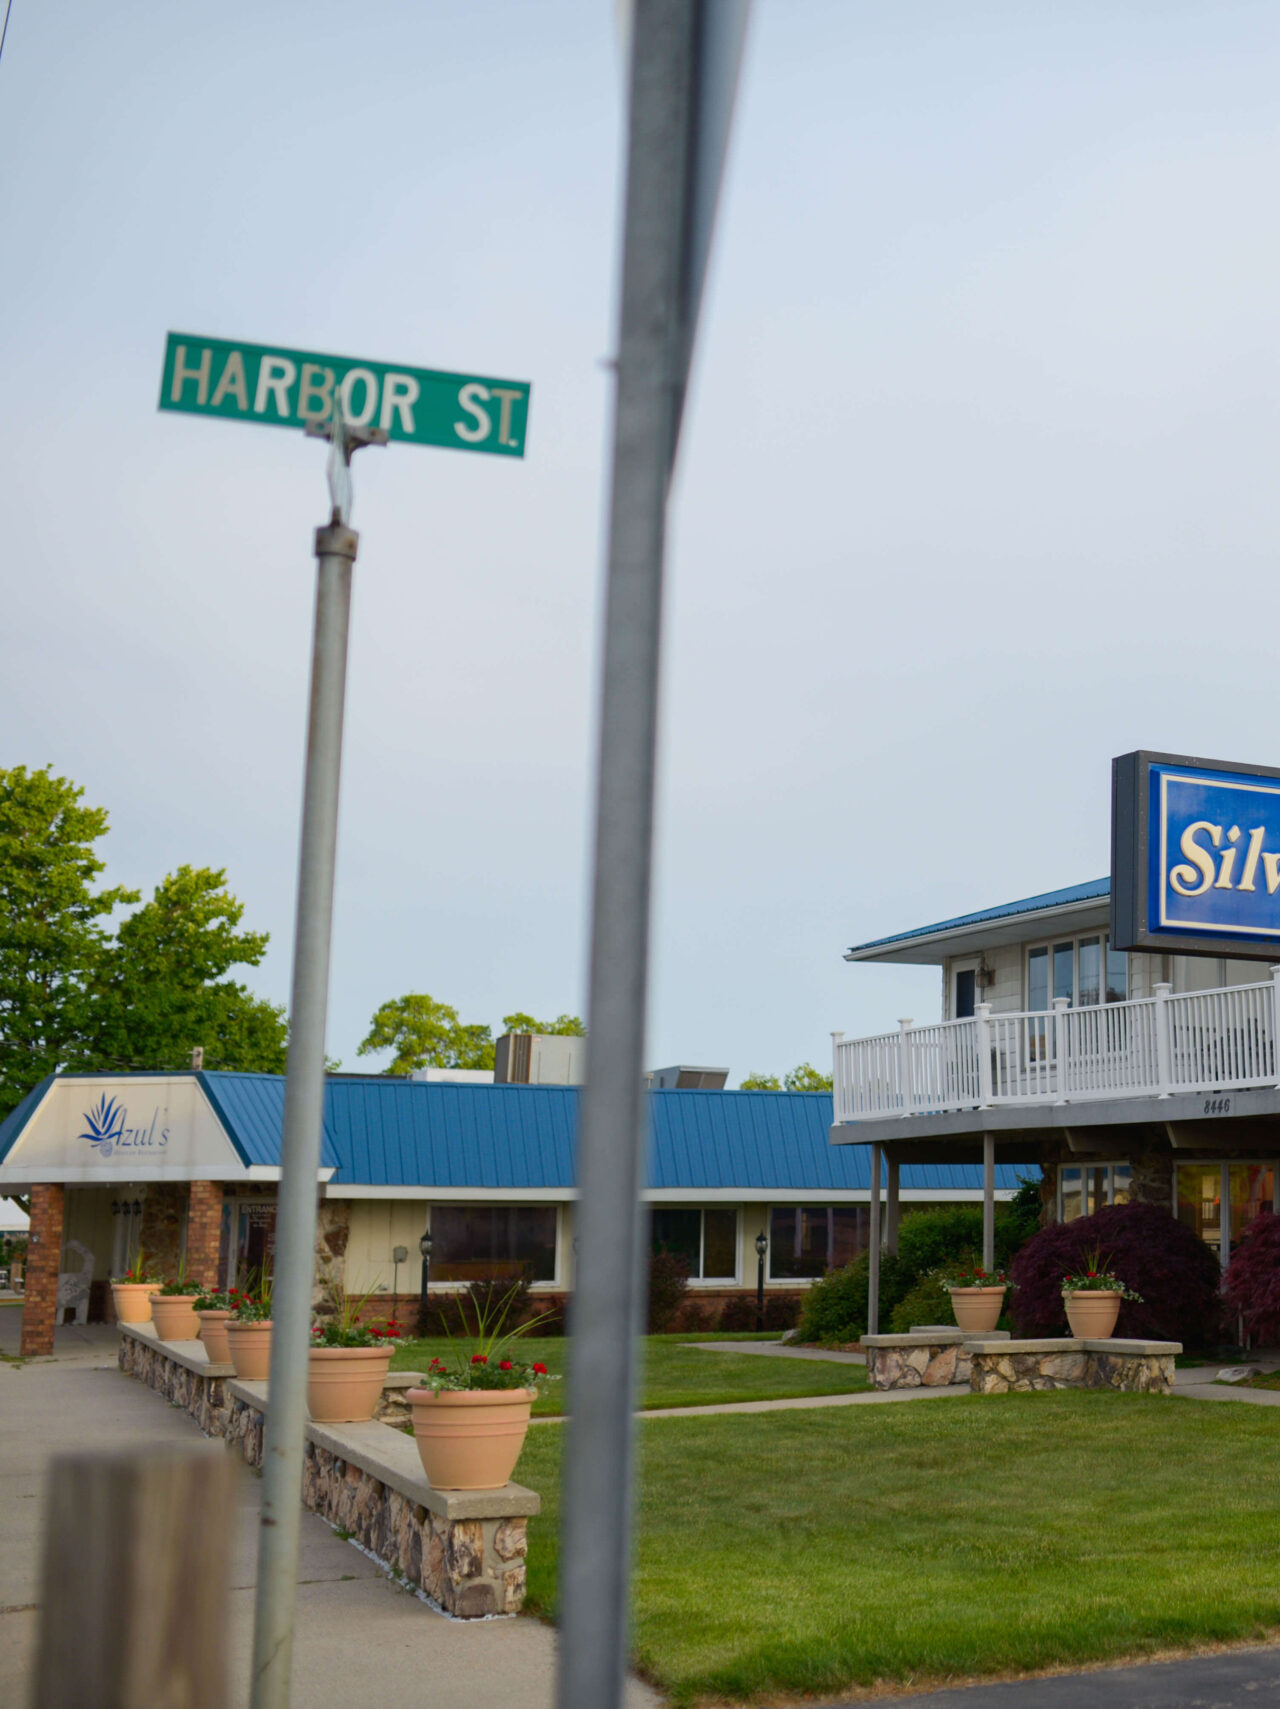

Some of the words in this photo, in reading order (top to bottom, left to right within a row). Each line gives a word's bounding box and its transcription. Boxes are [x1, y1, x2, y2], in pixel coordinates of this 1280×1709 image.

[170, 345, 420, 434] HARBOR
[454, 382, 524, 448] ST.
[110, 1105, 170, 1147] Azul's
[1204, 1098, 1231, 1115] 8446
